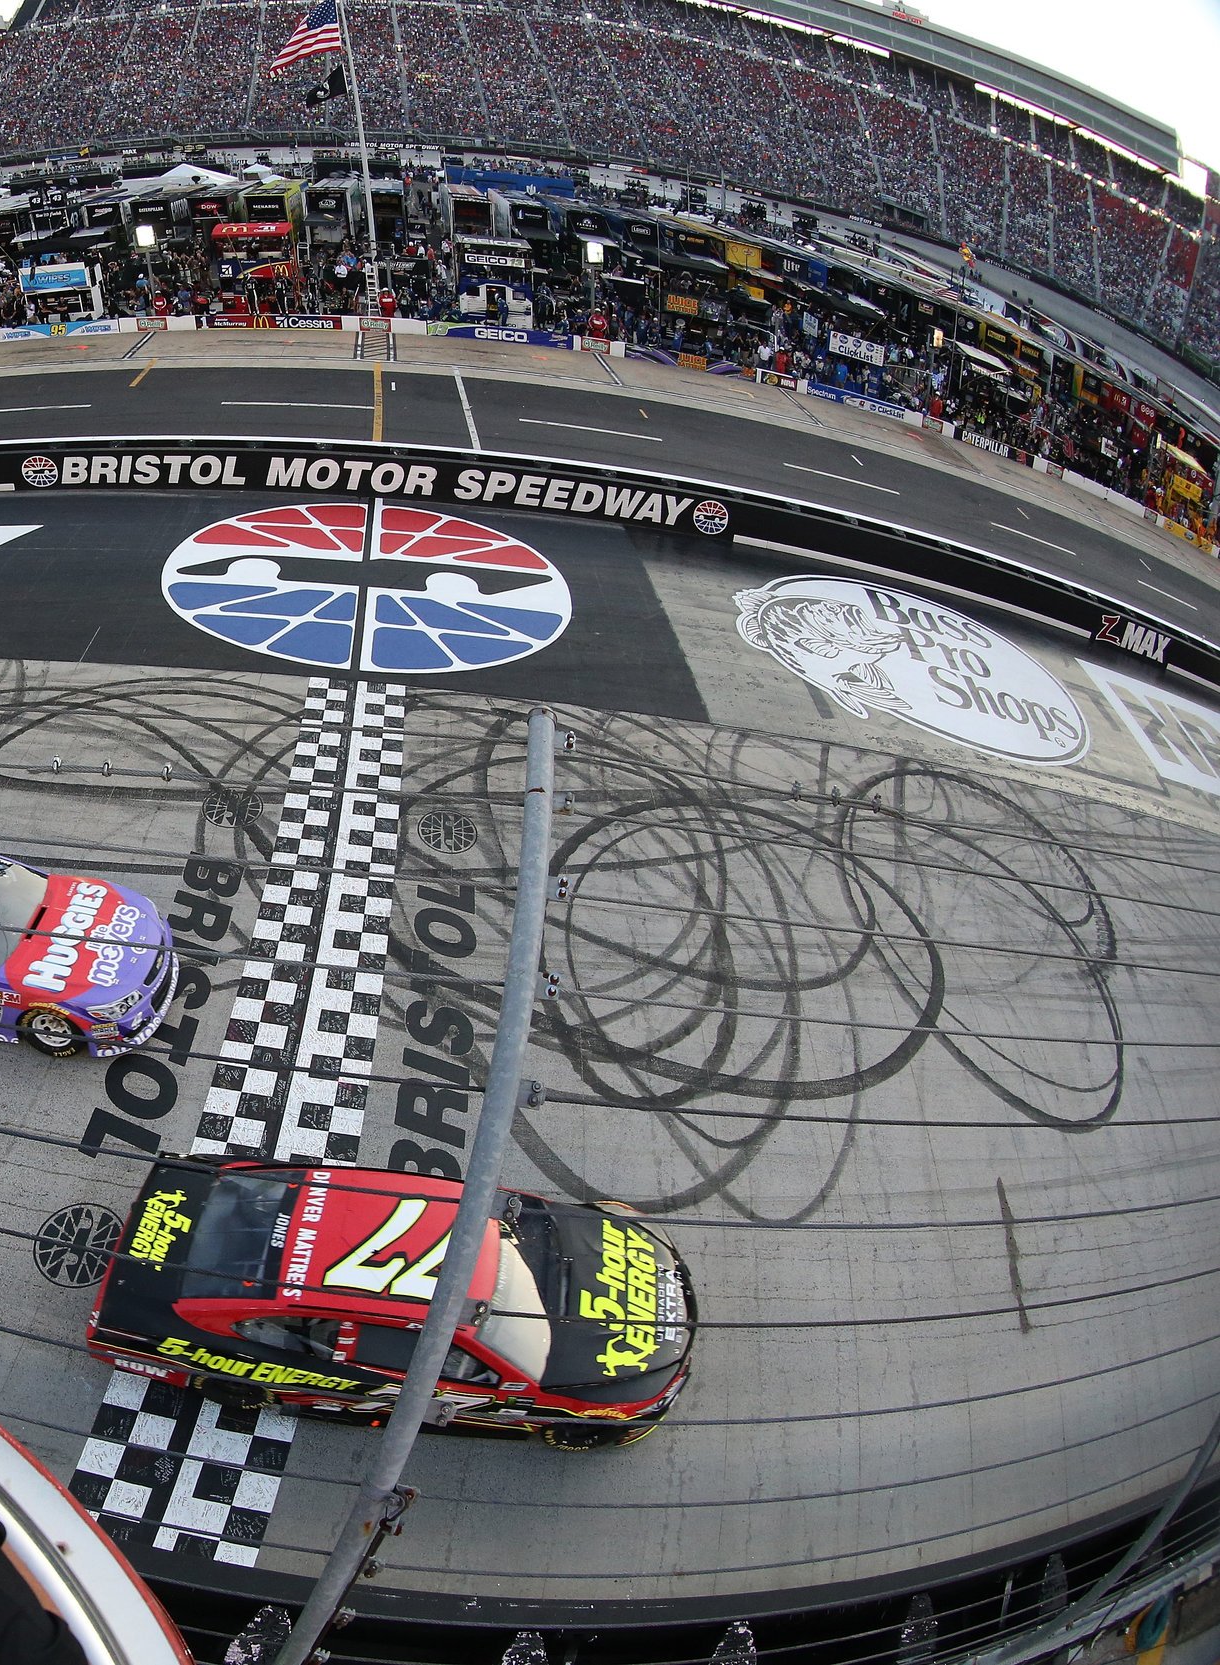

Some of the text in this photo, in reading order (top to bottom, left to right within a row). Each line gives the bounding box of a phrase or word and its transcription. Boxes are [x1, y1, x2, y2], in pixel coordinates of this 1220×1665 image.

[467, 255, 508, 265] GEICO
[783, 259, 801, 273] Lite
[37, 273, 71, 285] WIPES
[668, 294, 698, 308] JUICE
[49, 323, 67, 336] 95
[84, 324, 112, 333] WIPES
[288, 316, 334, 329] Cessna
[430, 323, 448, 335] 13
[6, 330, 31, 339] WIPES
[474, 327, 529, 344] GEICO
[680, 352, 708, 365] JUICE
[838, 344, 874, 363] ClickList
[781, 377, 795, 388] NRA
[807, 385, 836, 400] Spectrum
[877, 406, 905, 419] ClickList
[961, 430, 1010, 458] CATERPILLAR
[61, 454, 694, 527] BRISTOL MOTOR SPEEDWAY
[862, 587, 994, 650] Bass
[896, 626, 991, 680] Pro
[927, 663, 1080, 743] Shops
[21, 881, 109, 993] HUGGIES
[86, 903, 141, 988] movers
[2, 992, 20, 1004] 3M
[78, 850, 245, 1160] BRISTOL
[386, 883, 478, 1180] BRISTOL
[128, 1199, 164, 1266] ENERGY
[149, 1209, 193, 1272] 5-hour
[270, 1212, 291, 1249] JONES
[580, 1218, 627, 1332] 5-hour
[624, 1226, 659, 1348] ENERGY
[664, 1269, 677, 1342] EXTRA
[156, 1336, 361, 1391] 5-hour ENERGY
